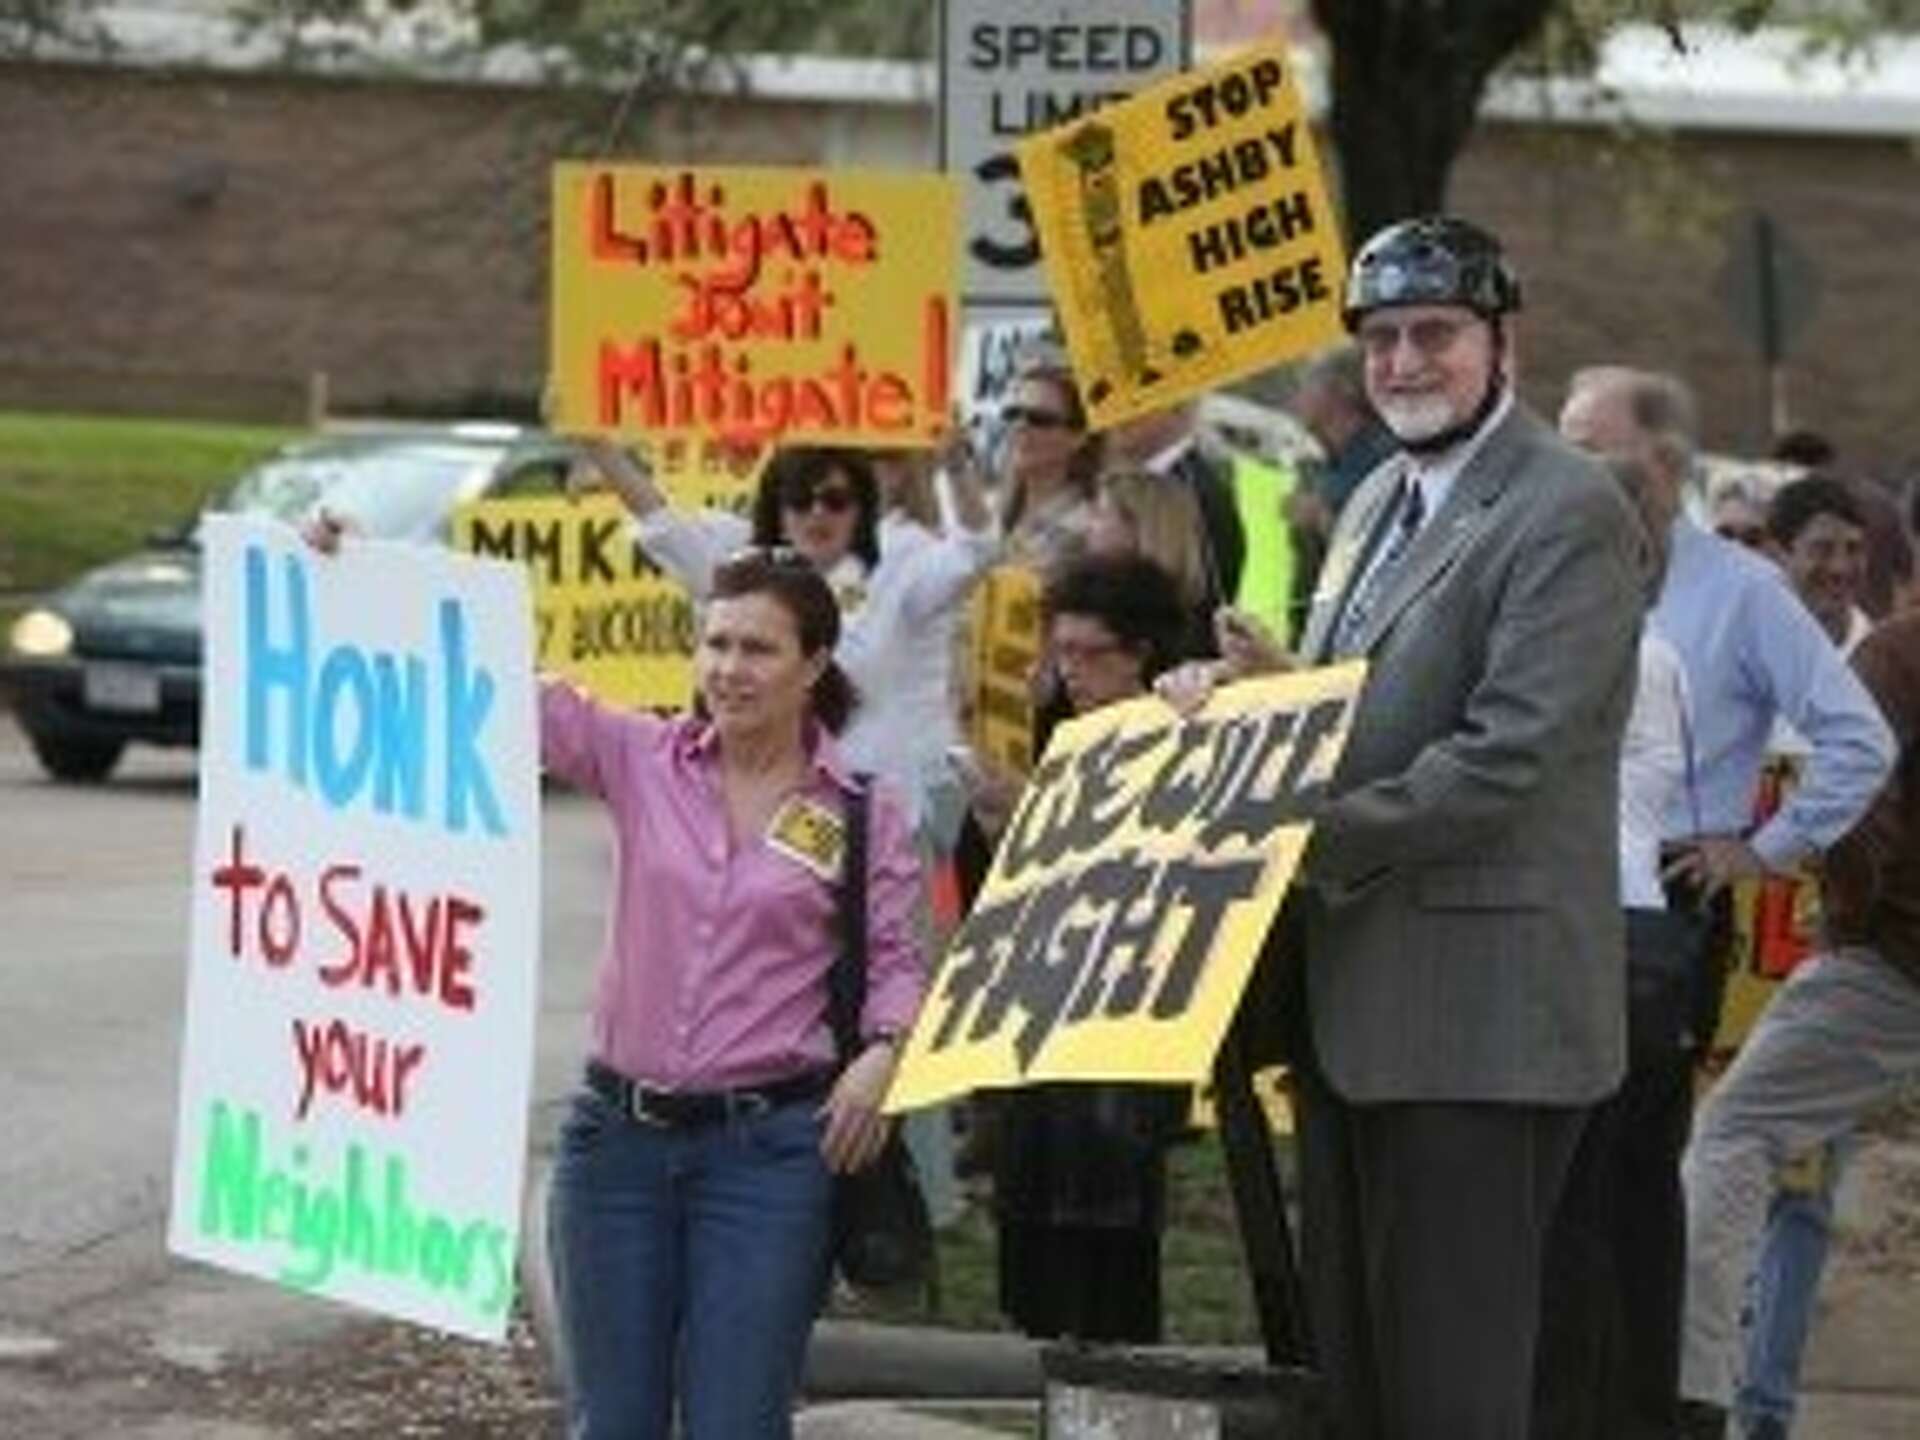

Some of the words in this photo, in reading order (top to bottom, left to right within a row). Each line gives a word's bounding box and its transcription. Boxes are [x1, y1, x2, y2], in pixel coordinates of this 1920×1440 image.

[970, 25, 1163, 71] SPEED
[992, 90, 1134, 136] LIM
[1166, 59, 1282, 142] STOP
[1137, 123, 1299, 228] ASHBY
[588, 172, 878, 293] Litigate
[1186, 192, 1313, 275] HIGH
[1217, 257, 1331, 336] RISE
[318, 864, 485, 1010] SAVE
[929, 851, 1268, 1075] FIGHT
[293, 1017, 426, 1121] your
[200, 1098, 509, 1315] Neighbors
